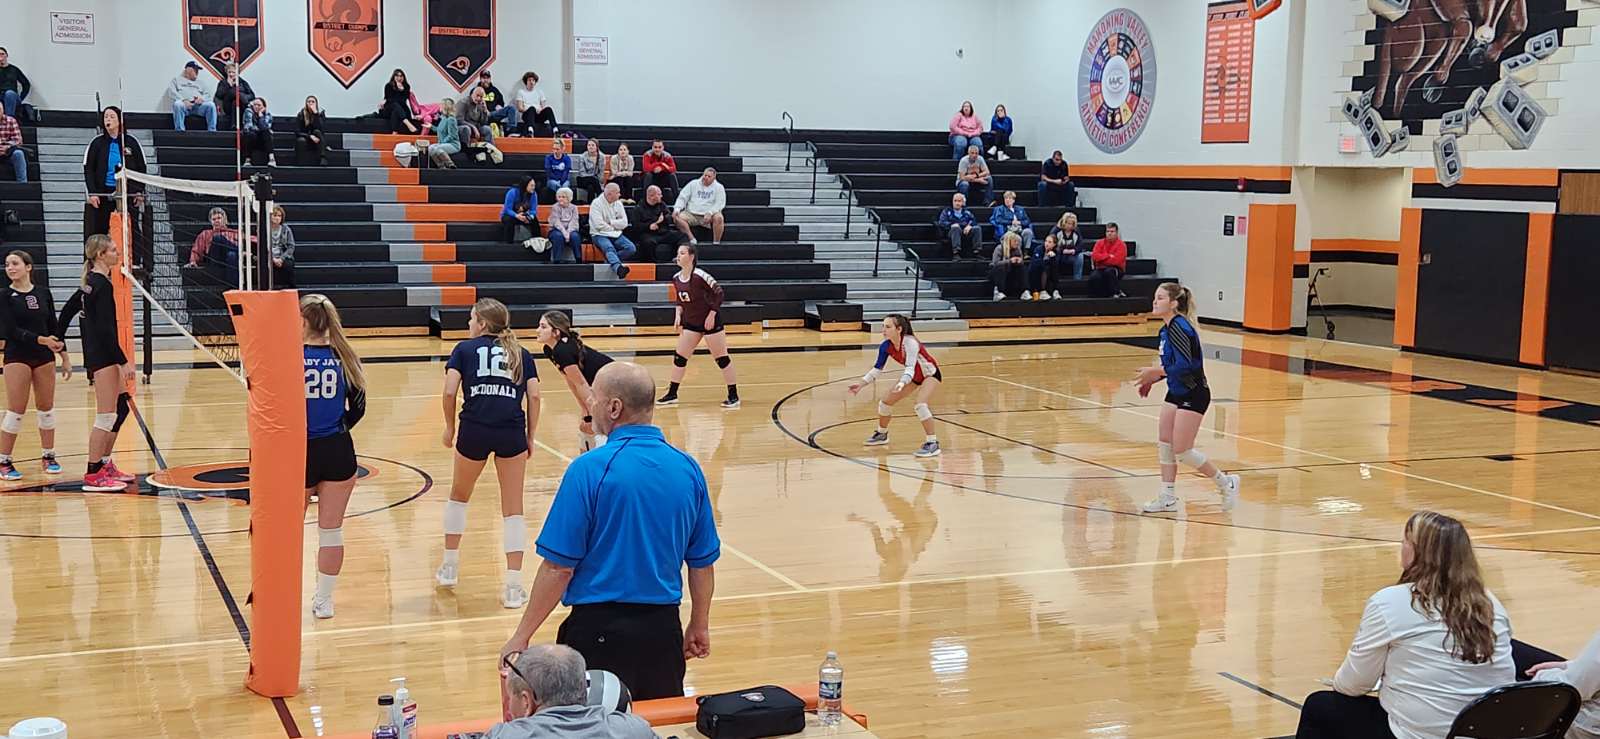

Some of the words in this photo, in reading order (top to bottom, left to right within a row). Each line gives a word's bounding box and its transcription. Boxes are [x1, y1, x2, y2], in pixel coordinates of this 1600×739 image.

[1087, 12, 1125, 55] MAHONING
[1126, 14, 1149, 50] VALLEY
[1081, 103, 1107, 145] ATHLETIC
[1109, 96, 1151, 148] CONFERENCE
[26, 295, 39, 309] 2
[678, 291, 691, 302] 13
[303, 358, 320, 366] ADY
[321, 358, 342, 366] JAY
[476, 346, 512, 380] 12
[304, 368, 338, 399] 28
